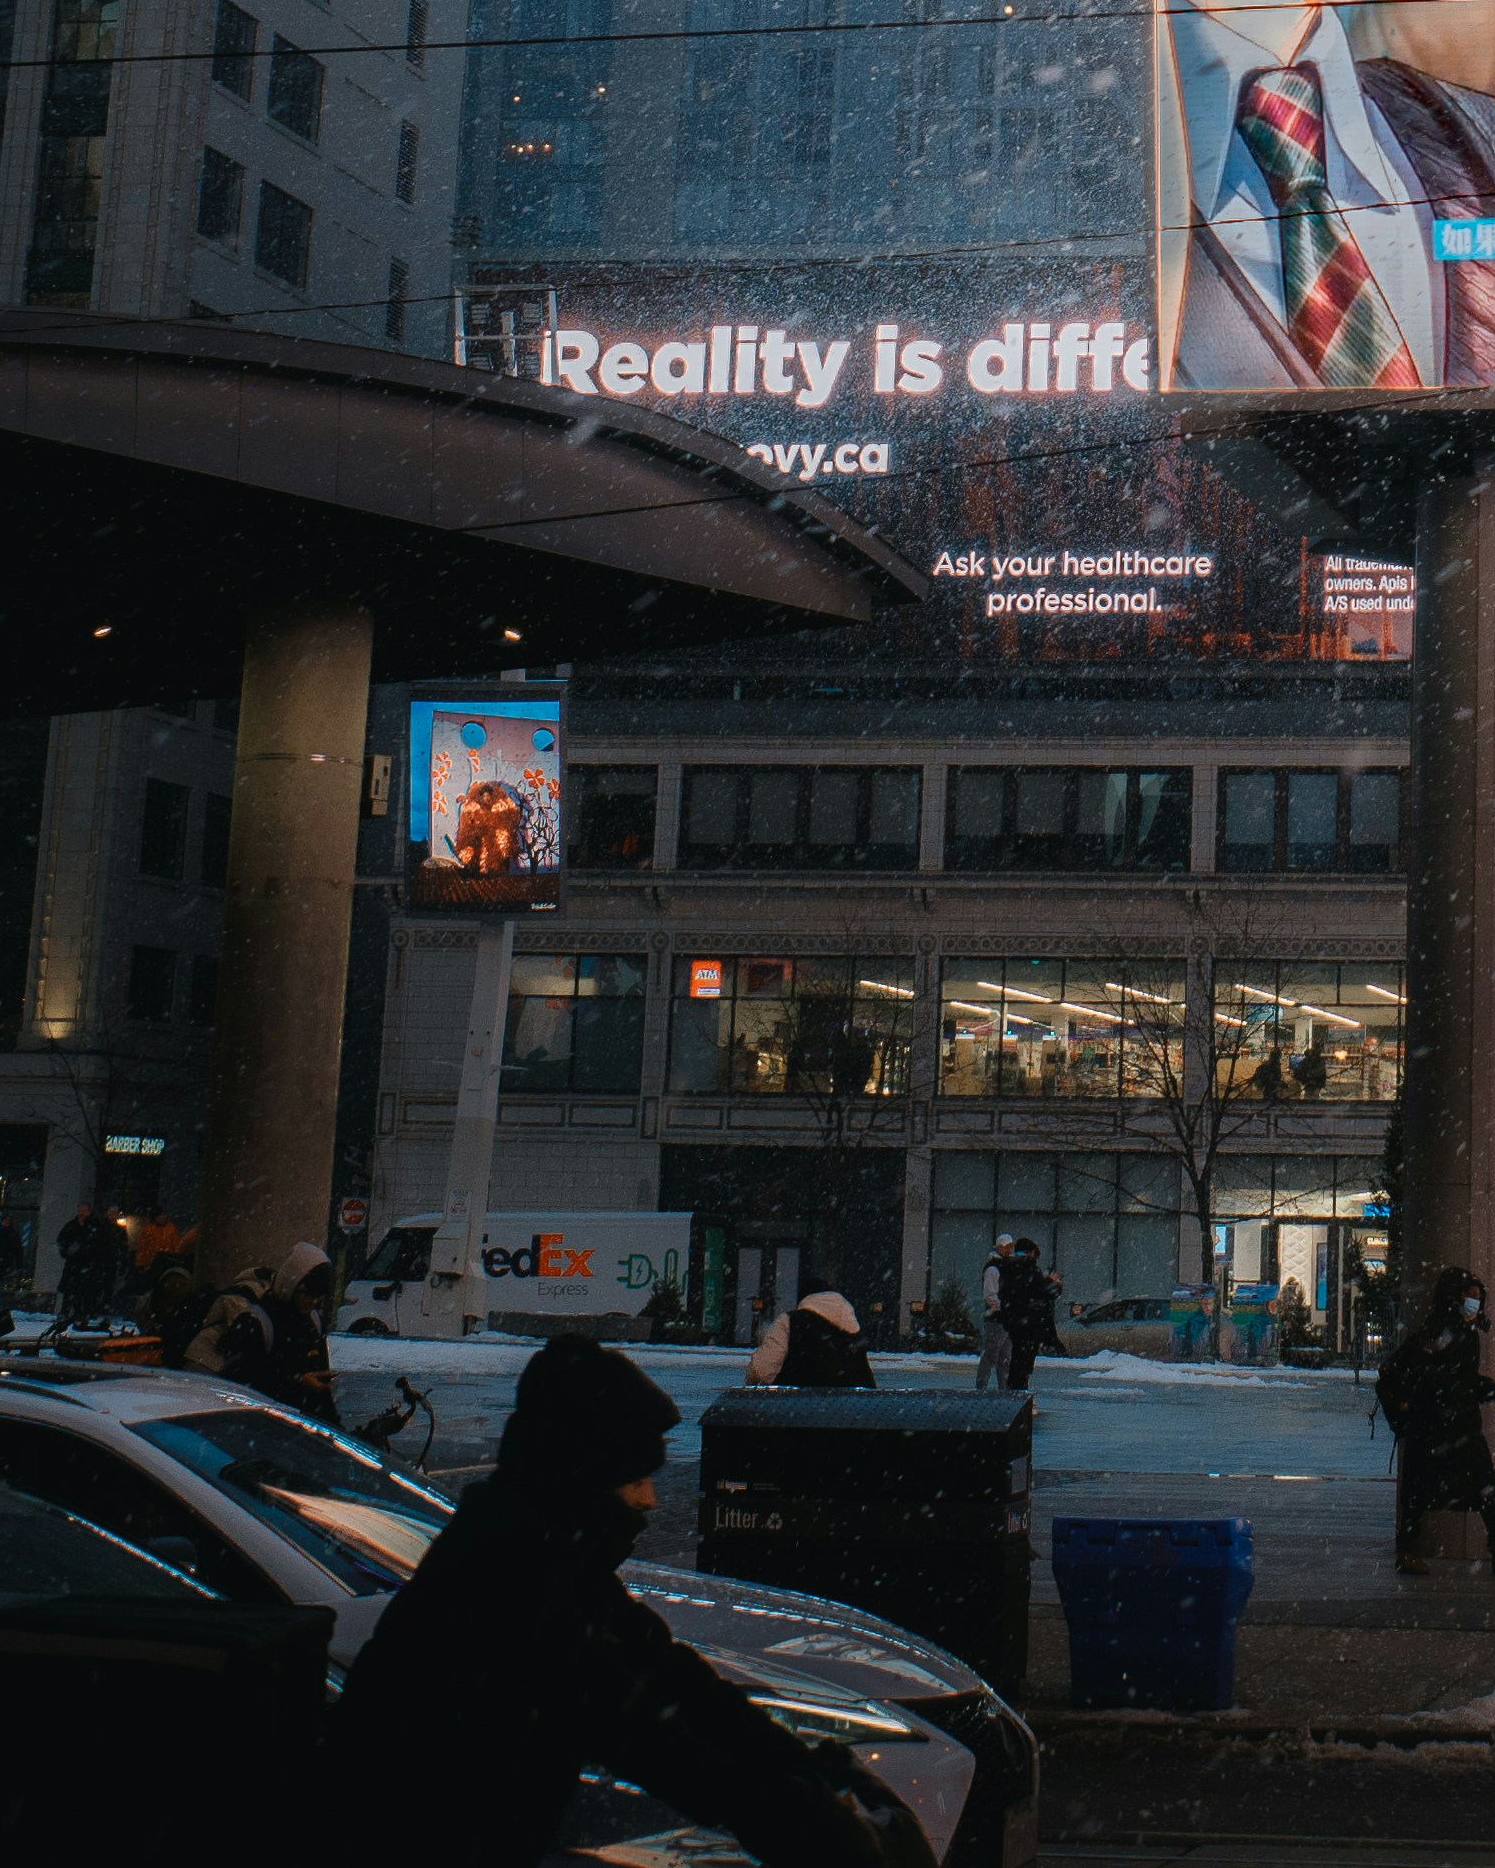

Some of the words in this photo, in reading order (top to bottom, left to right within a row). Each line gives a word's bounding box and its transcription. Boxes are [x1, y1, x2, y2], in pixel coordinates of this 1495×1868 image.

[543, 323, 850, 407] Reality
[875, 324, 944, 392] is
[933, 551, 985, 577] Ask
[991, 557, 1055, 581] your
[1061, 551, 1212, 578] healthcare
[1325, 577, 1377, 591] owners.
[1378, 574, 1408, 593] Apis
[986, 588, 1163, 616] professional.
[1324, 595, 1348, 611] A/S
[1351, 595, 1383, 611] used
[1386, 595, 1414, 611] und
[694, 969, 719, 981] ATM
[105, 1134, 141, 1153] BARBER
[141, 1137, 166, 1155] SHOP
[537, 1281, 589, 1298] Express
[715, 1506, 759, 1530] Litter
